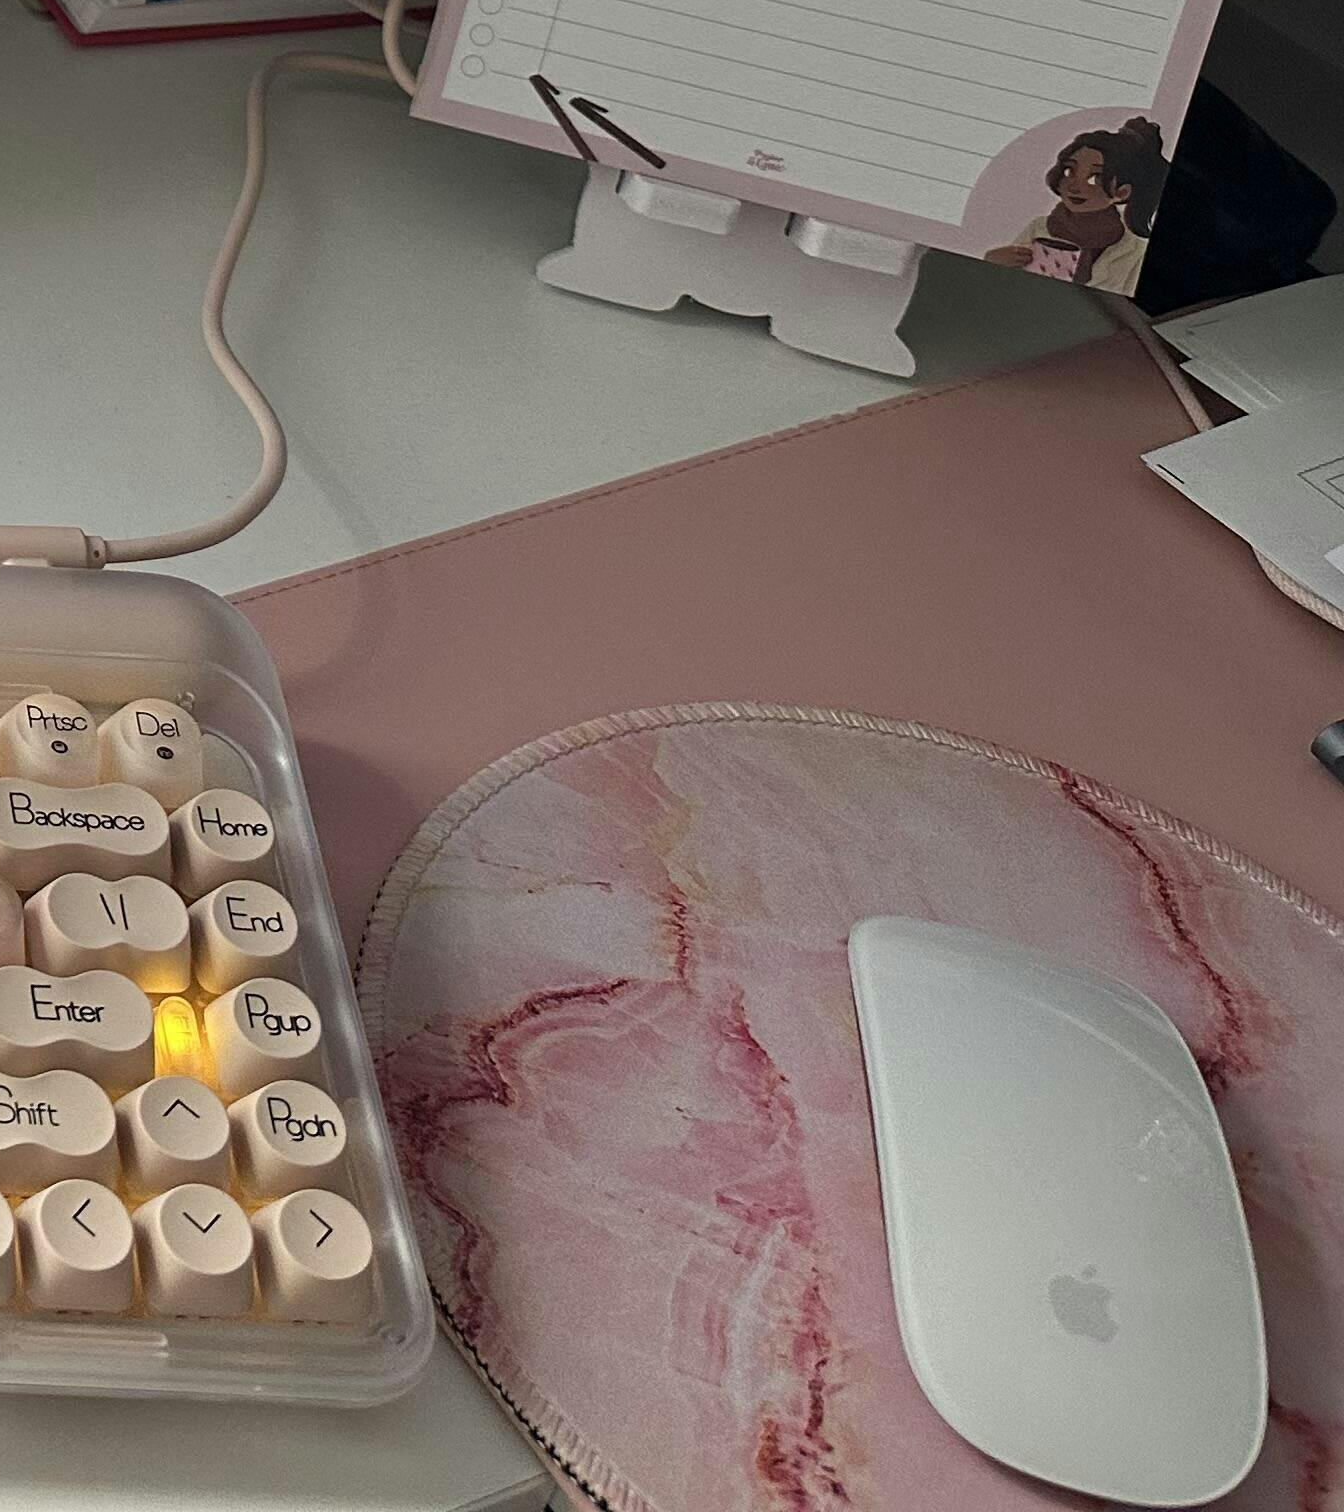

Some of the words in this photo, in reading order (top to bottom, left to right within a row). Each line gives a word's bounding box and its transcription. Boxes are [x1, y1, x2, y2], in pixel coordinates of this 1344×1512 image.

[25, 704, 89, 735] Prtsc
[134, 710, 182, 740] Del
[8, 790, 146, 834] Backspace
[196, 805, 269, 839] Home
[225, 895, 285, 935] End
[29, 983, 106, 1026] Enter
[244, 992, 313, 1038] Pgup
[266, 1096, 339, 1142] Pgdn
